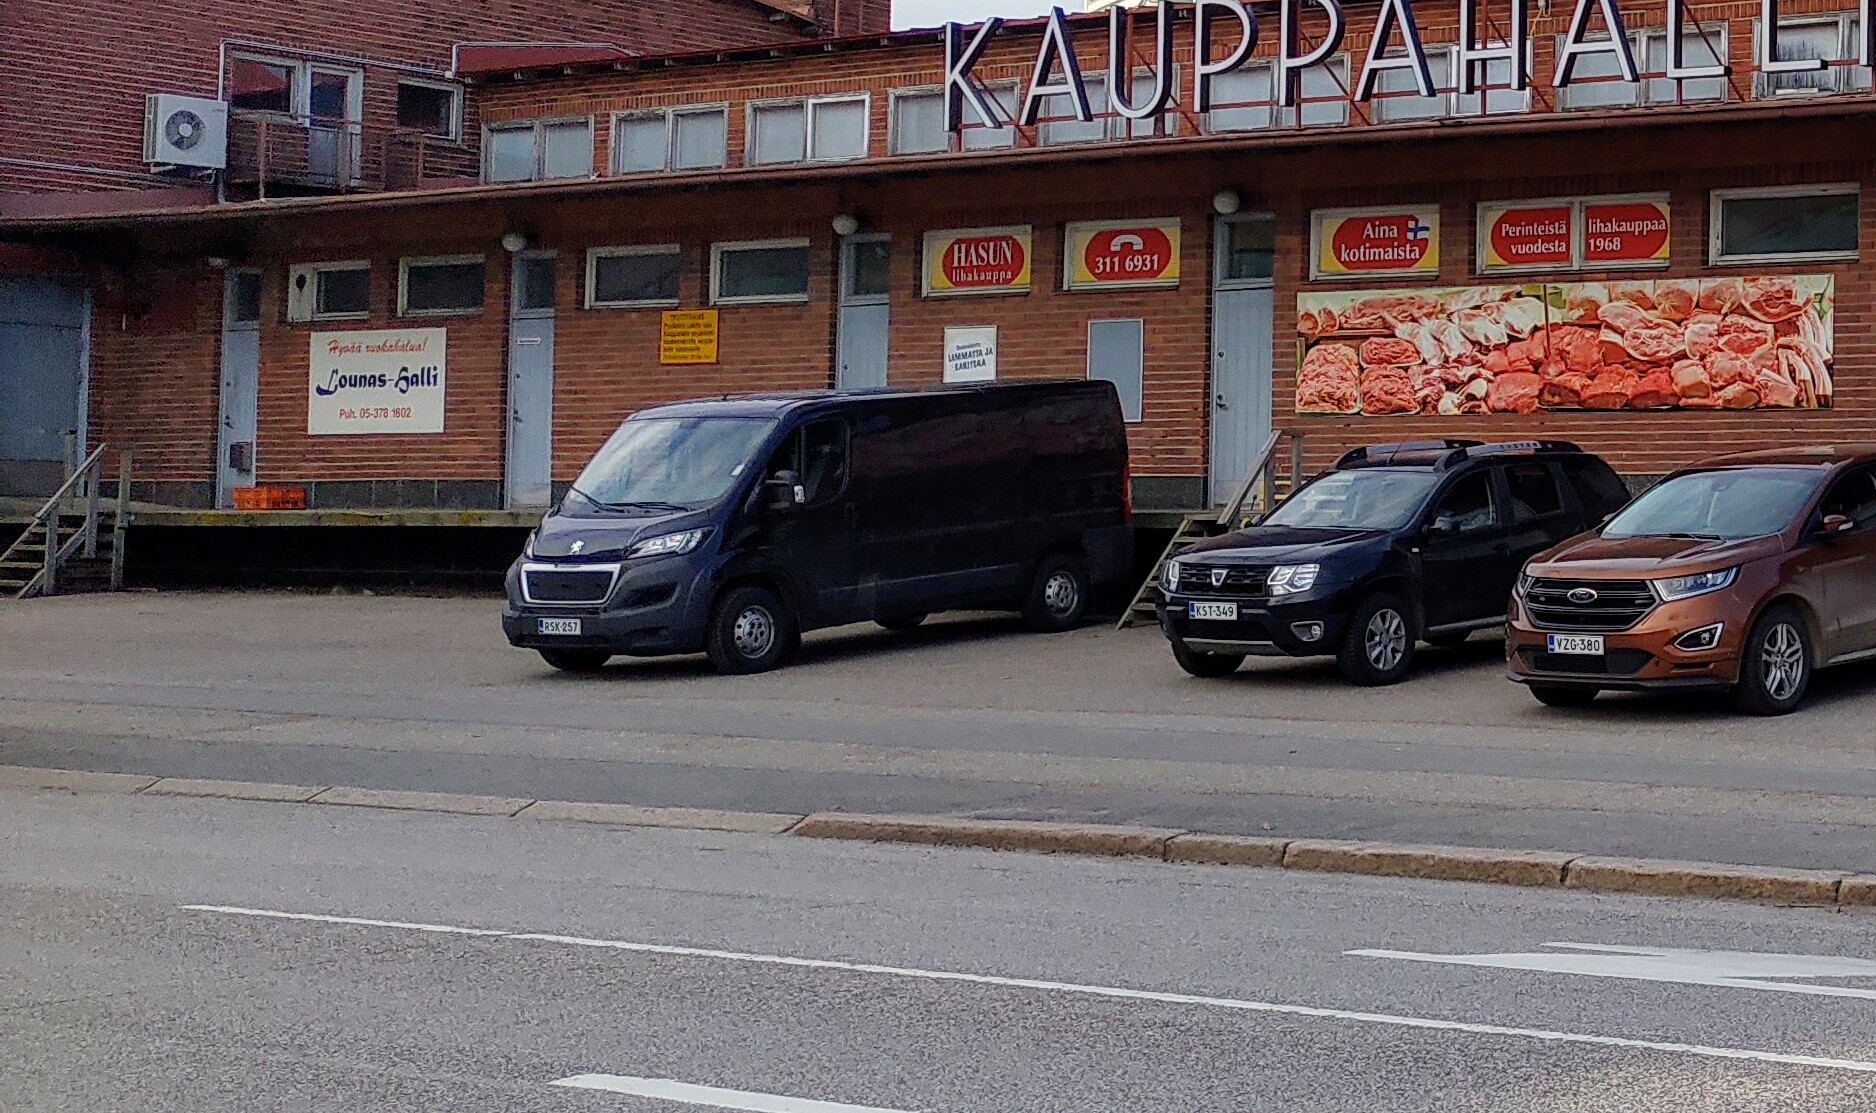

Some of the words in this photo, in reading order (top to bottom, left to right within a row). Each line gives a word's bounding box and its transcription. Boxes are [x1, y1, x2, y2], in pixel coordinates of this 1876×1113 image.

[1363, 221, 1398, 239] Aina
[1501, 220, 1567, 237] Perinteistä
[1588, 218, 1666, 235] lihakauppaa
[952, 241, 1012, 267] HASUN
[1340, 242, 1420, 262] kotimaista
[1511, 239, 1566, 255] vuodesta
[1588, 237, 1621, 252] 1968
[1095, 255, 1119, 274] 311
[1125, 253, 1159, 272] 6931
[952, 268, 1012, 284] lihakauppa
[984, 346, 994, 356] JA
[315, 366, 439, 396] Lounas-Halli
[1196, 605, 1235, 617] KST-349
[544, 621, 578, 633] RSK-257
[1556, 637, 1600, 652] VZG-380
